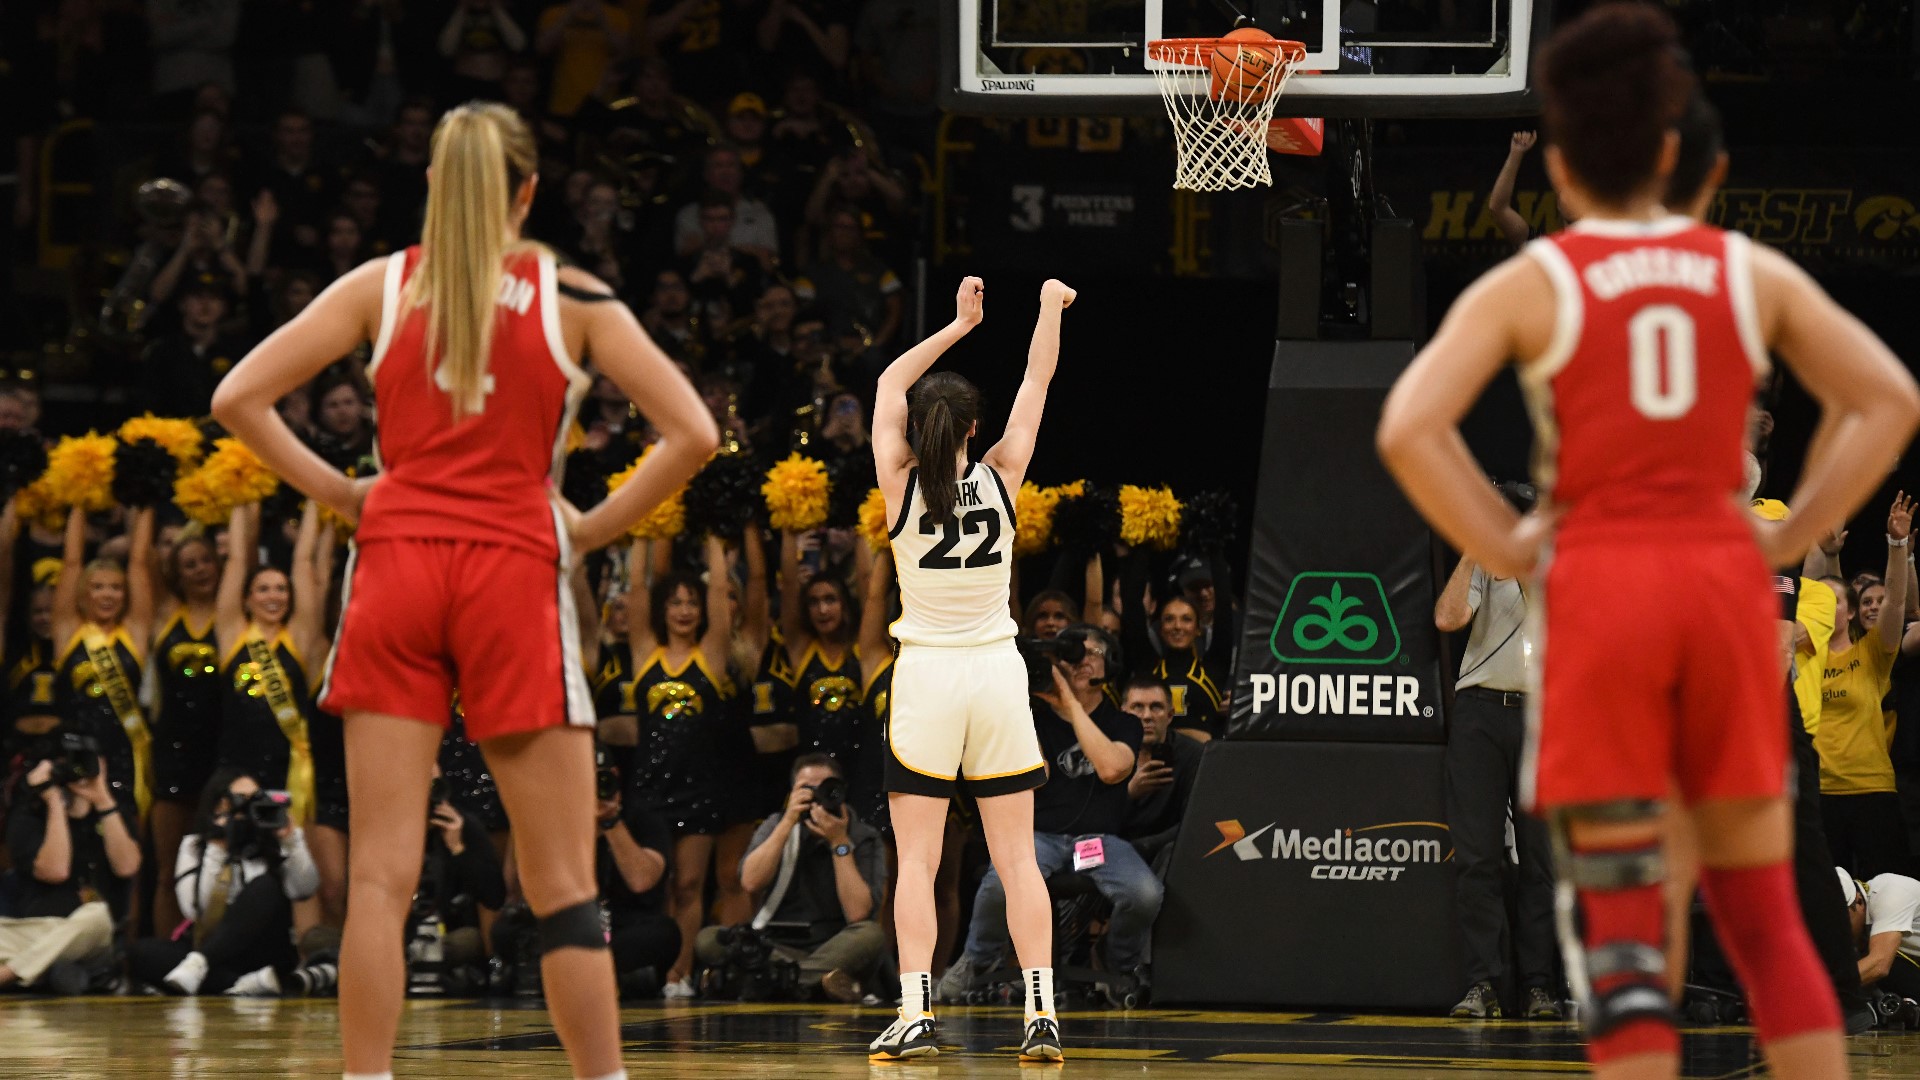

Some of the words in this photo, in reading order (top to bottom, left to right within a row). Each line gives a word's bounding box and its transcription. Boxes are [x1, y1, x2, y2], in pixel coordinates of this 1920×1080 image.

[981, 79, 1034, 91] SPALDING
[1009, 184, 1045, 232] 3
[1628, 303, 1698, 420] 0
[919, 508, 1002, 569] 22
[1250, 674, 1420, 716] PIONEER
[1822, 689, 1847, 703] glue
[1271, 827, 1441, 863] Mediacom
[1310, 865, 1405, 881] COURT
